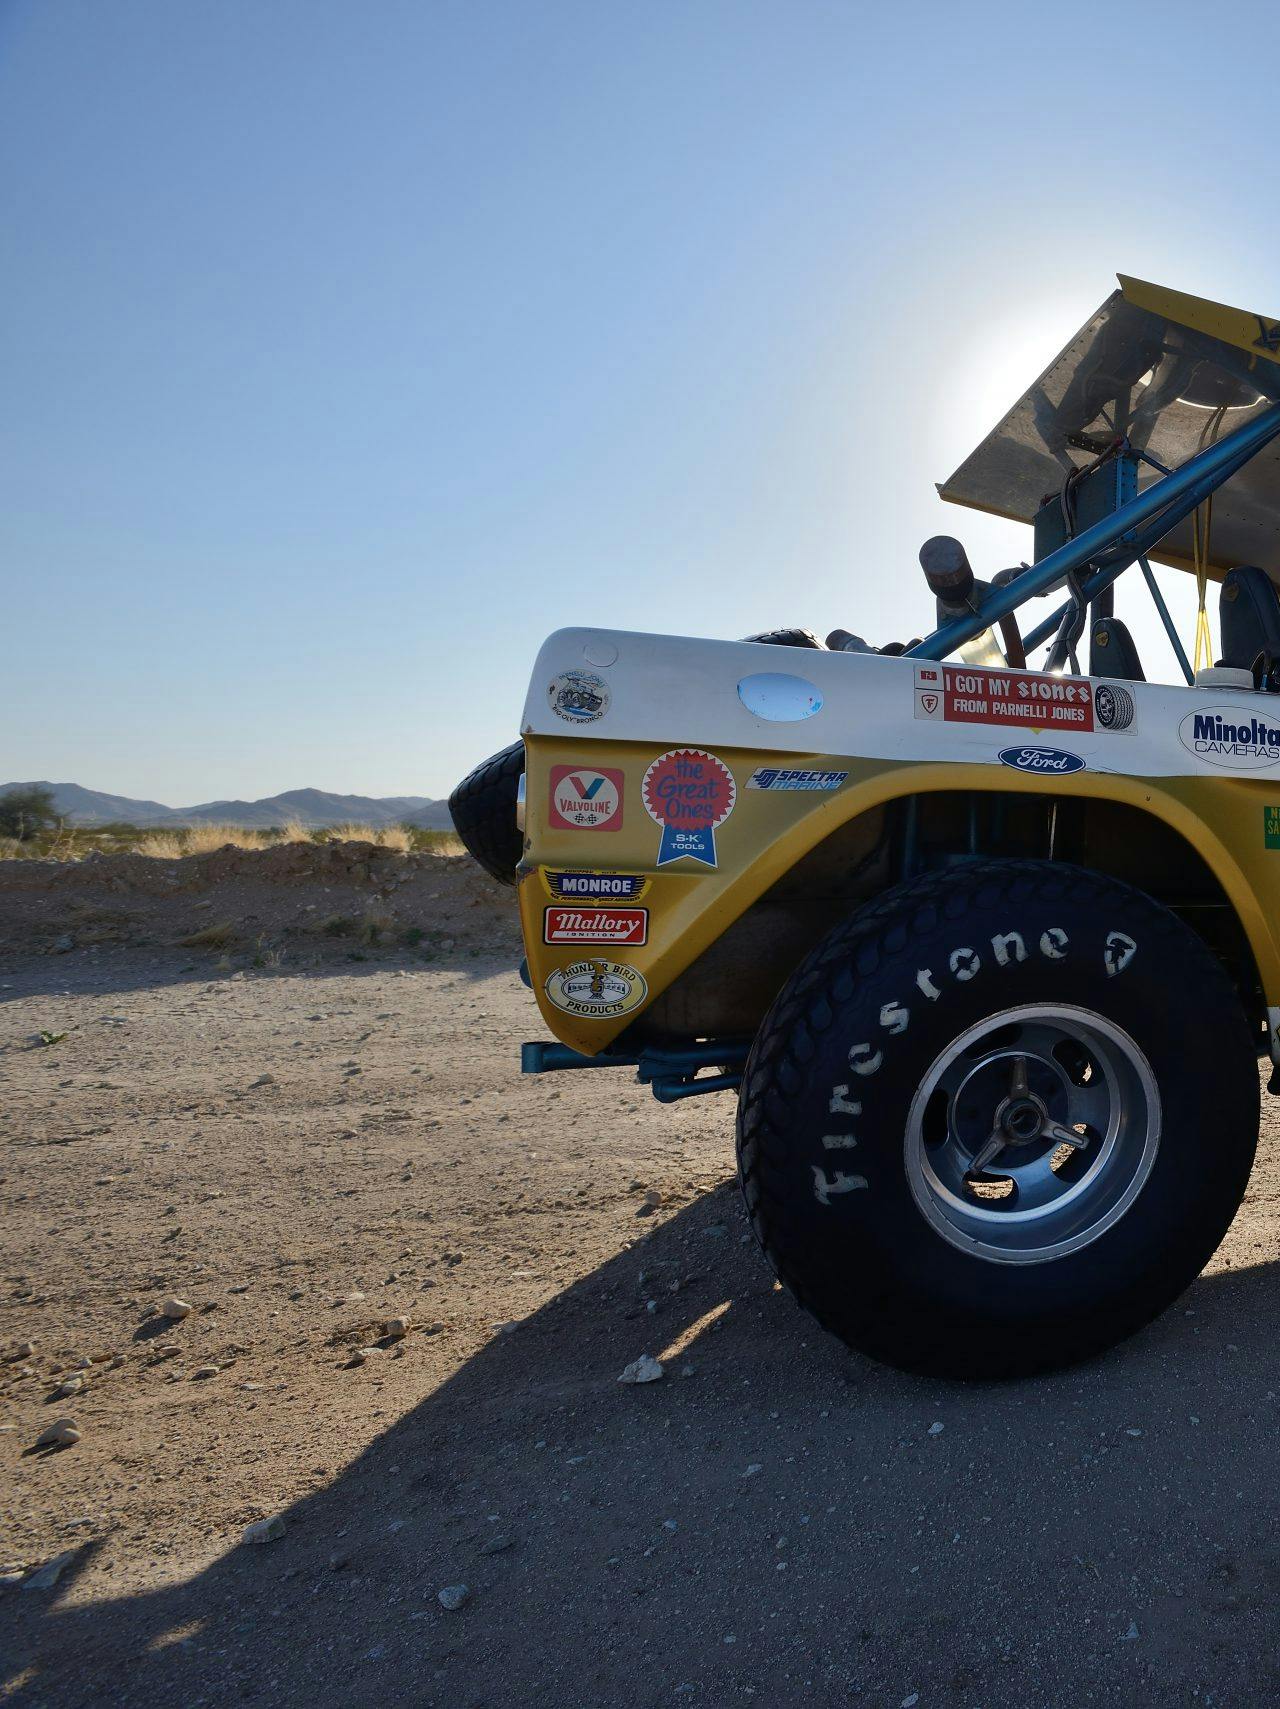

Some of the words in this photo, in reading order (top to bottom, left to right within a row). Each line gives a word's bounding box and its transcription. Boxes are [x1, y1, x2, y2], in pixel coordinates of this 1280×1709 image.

[945, 673, 951, 692] I
[955, 673, 984, 694] GOT
[989, 679, 1010, 697] MY
[953, 699, 988, 714] FROM
[993, 702, 1047, 719] PARNELLI
[1051, 707, 1085, 721] JONES
[1193, 714, 1280, 747] Minolta
[1016, 749, 1068, 770] Ford
[1194, 740, 1280, 759] CAMERAS
[675, 758, 704, 780] the
[777, 770, 849, 782] SPECTRA
[656, 775, 720, 800] Great
[770, 781, 842, 790] MARINE
[560, 799, 611, 815] VALVOLINE
[664, 799, 714, 819] Ones
[562, 878, 632, 893] MONROE
[556, 913, 641, 933] Mallory
[558, 961, 609, 980] THUNDR
[612, 965, 636, 981] BIRD
[566, 1001, 624, 1014] PRODUCTS
[811, 927, 1070, 1206] Firestone
